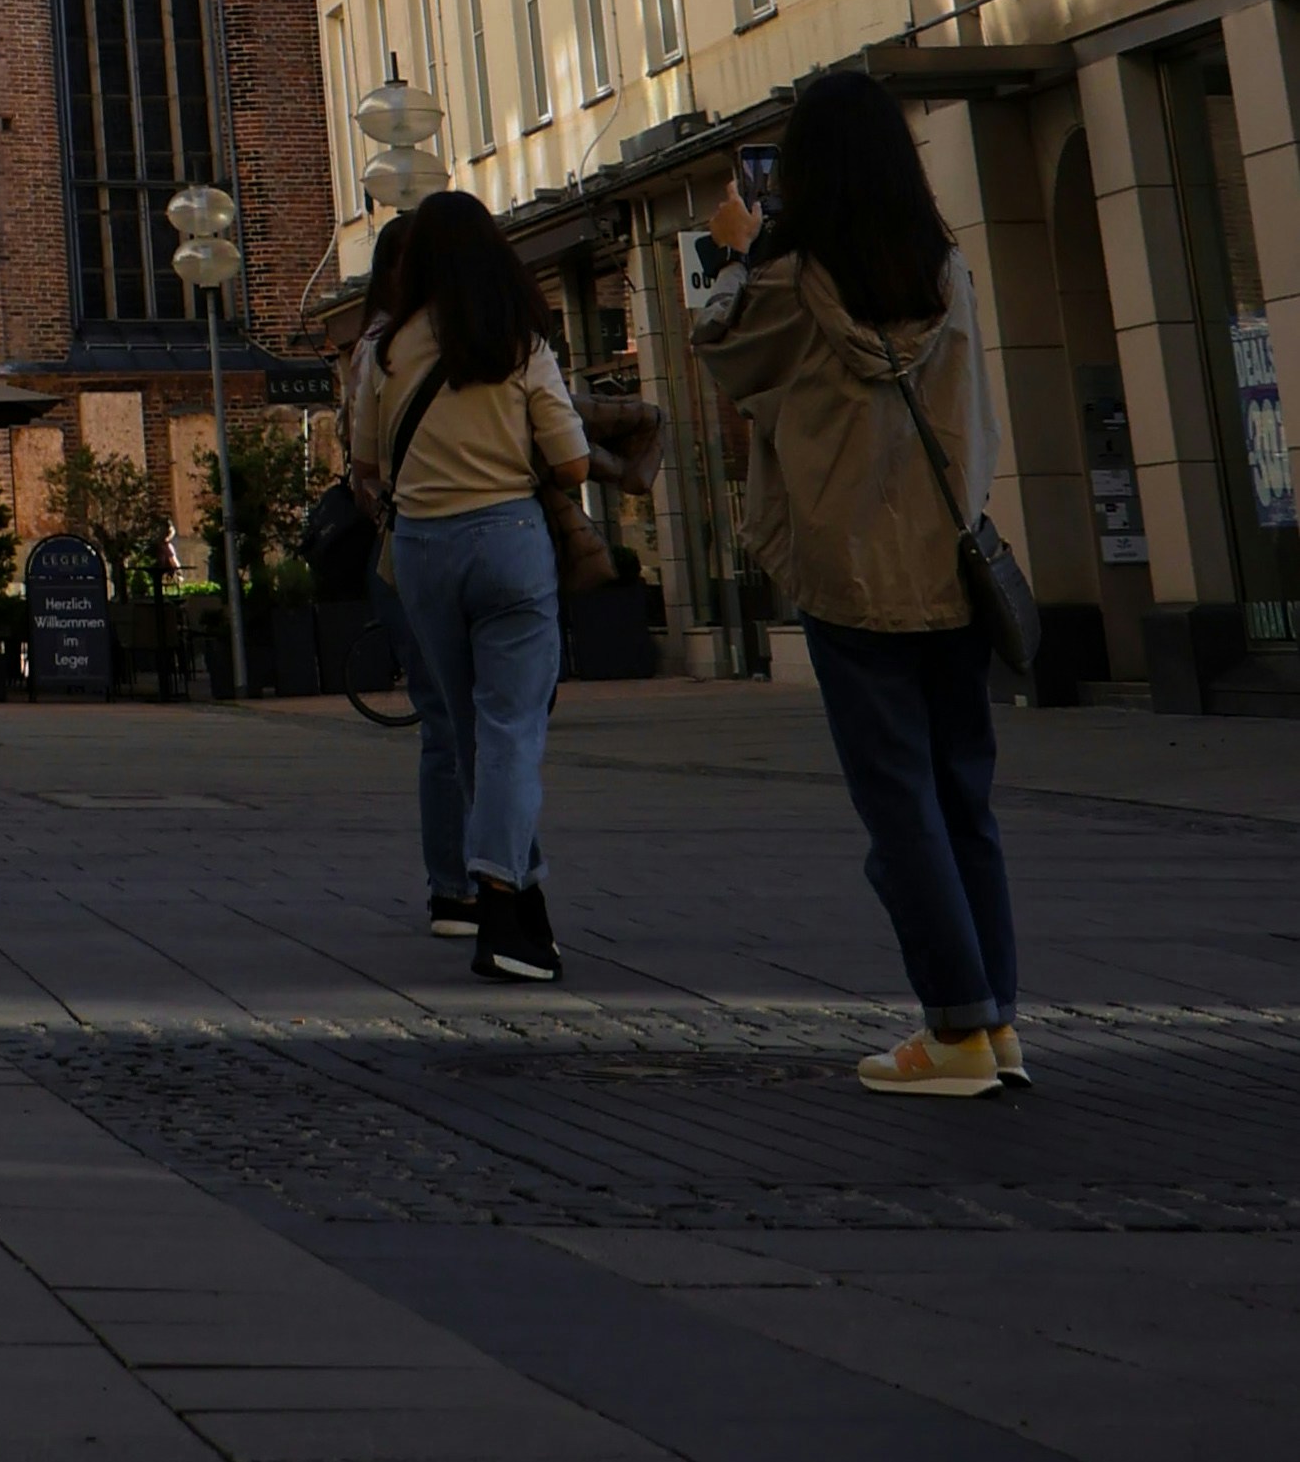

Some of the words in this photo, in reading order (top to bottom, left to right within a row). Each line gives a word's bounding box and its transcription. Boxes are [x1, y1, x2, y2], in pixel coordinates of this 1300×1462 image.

[270, 379, 331, 393] LEGER
[42, 555, 89, 566] LEGER
[45, 597, 92, 610] Herzlich
[34, 615, 105, 629] Willkommen
[63, 635, 79, 647] im
[55, 653, 89, 669] Leger
